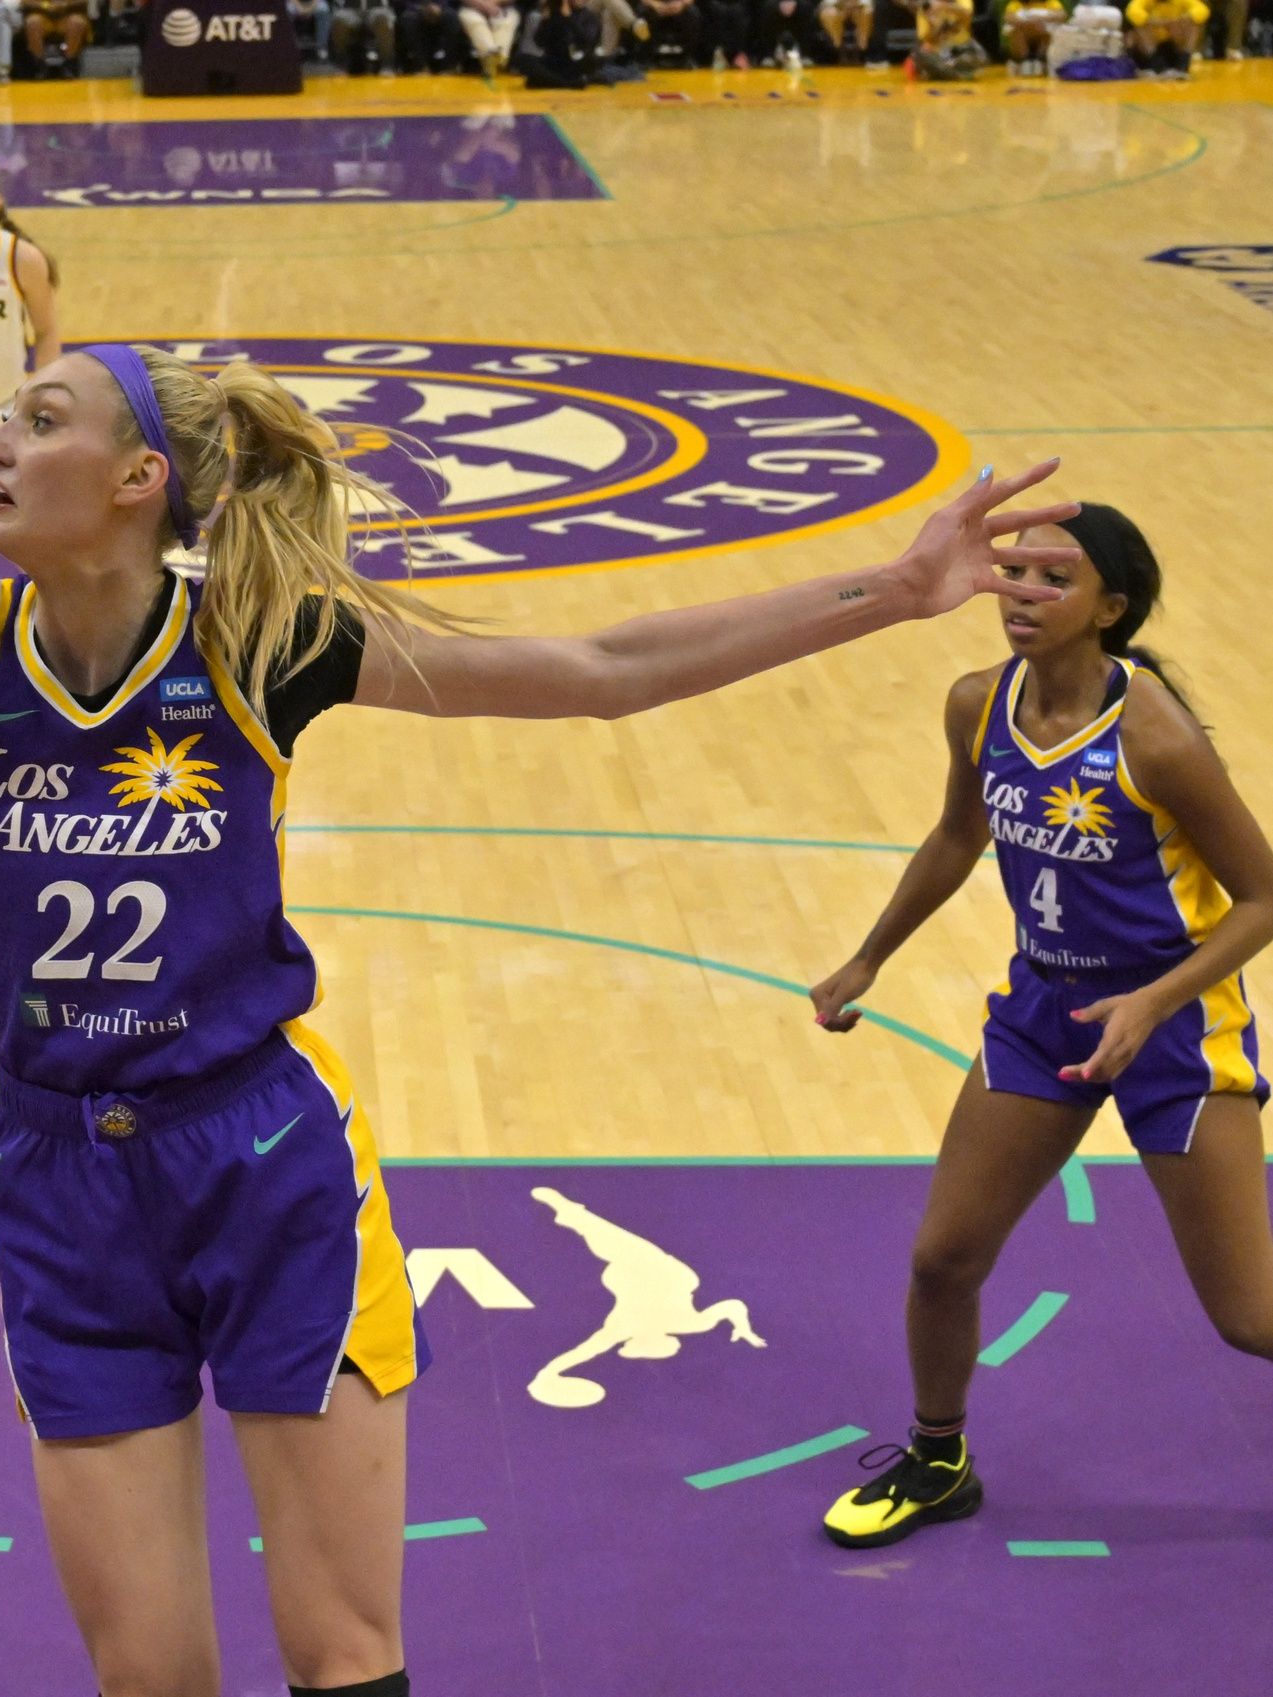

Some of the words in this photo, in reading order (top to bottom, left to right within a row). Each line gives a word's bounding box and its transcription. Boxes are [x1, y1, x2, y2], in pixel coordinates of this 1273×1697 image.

[205, 14, 277, 42] AT&T
[166, 682, 204, 697] UCLA
[1030, 867, 1064, 934] 4
[32, 880, 167, 982] 22
[1029, 939, 1110, 968] EquiTrust
[61, 1003, 189, 1039] EquiTrust
